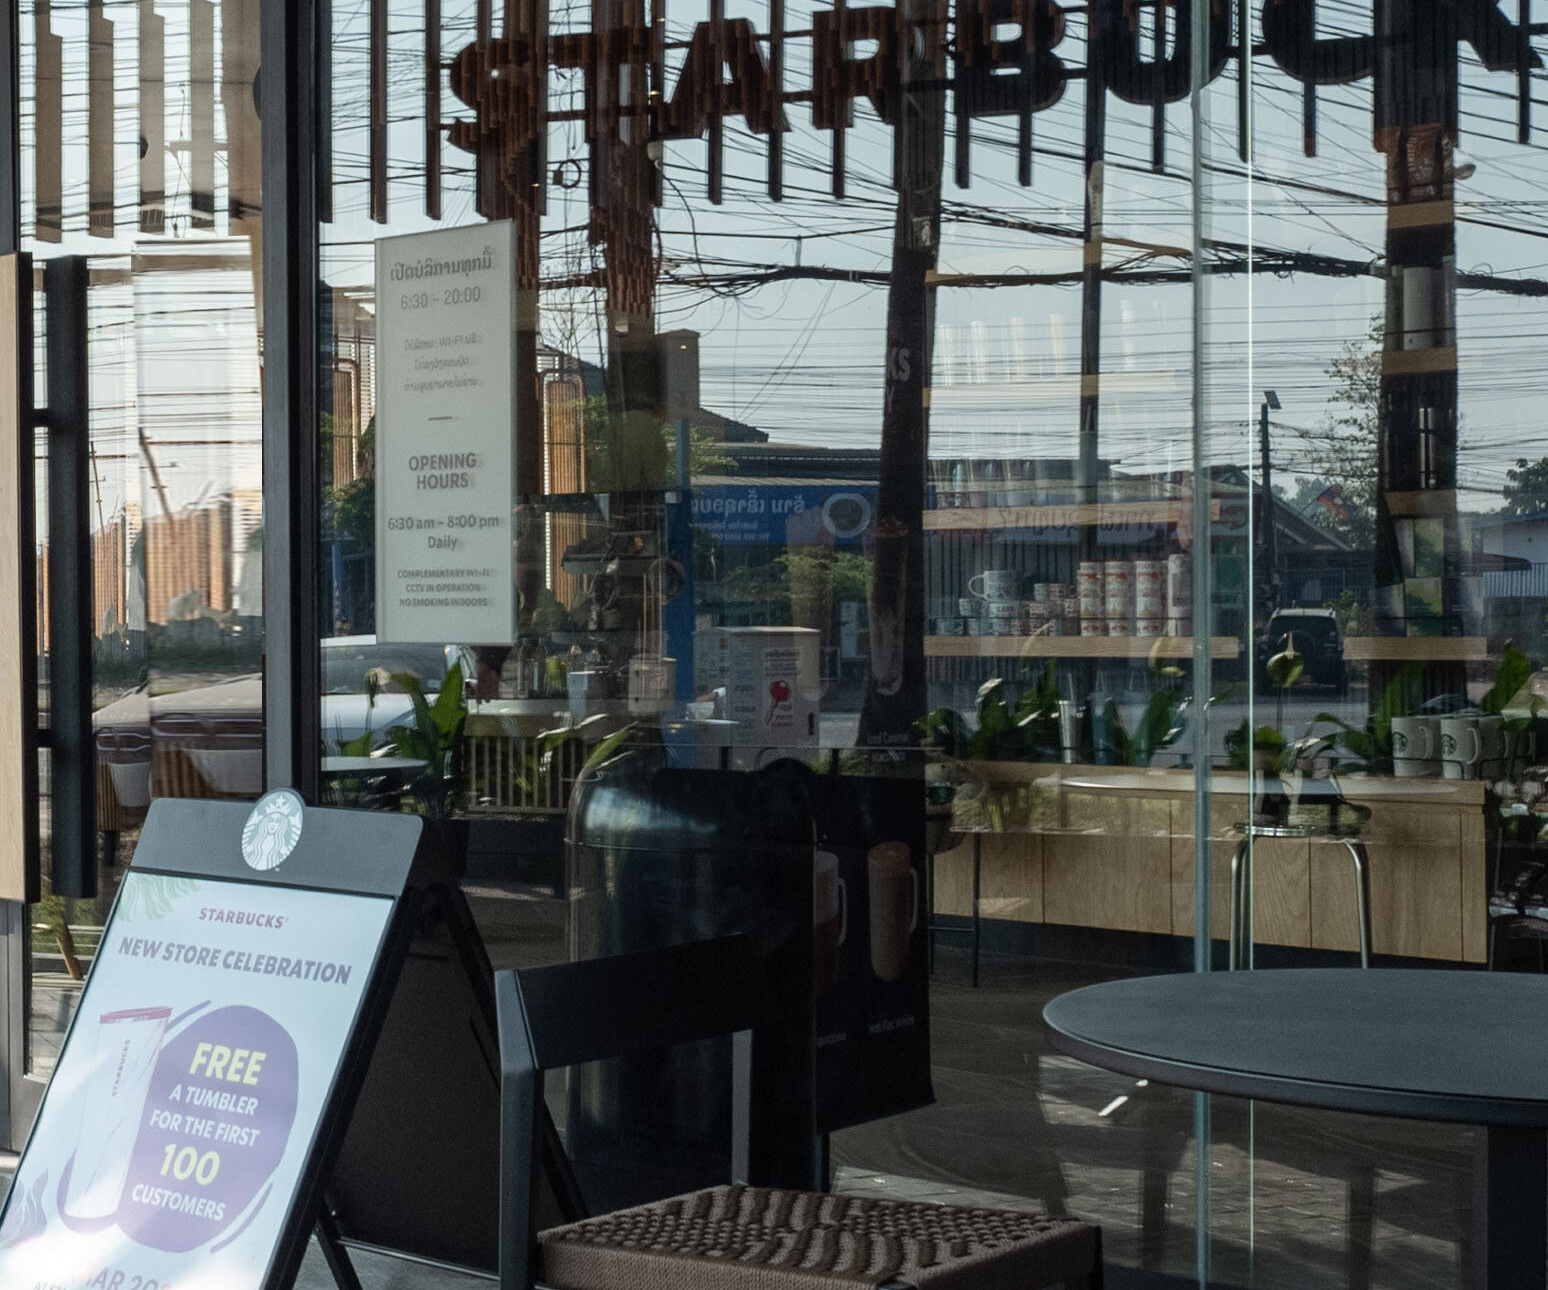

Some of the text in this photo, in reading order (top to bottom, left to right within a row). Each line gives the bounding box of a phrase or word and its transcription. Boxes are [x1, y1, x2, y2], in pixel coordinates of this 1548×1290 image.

[400, 292, 428, 311] 6:30
[444, 286, 481, 305] 20:00
[408, 452, 477, 471] OPENING
[417, 472, 469, 490] HOURS
[388, 517, 414, 530] 6:30
[416, 520, 434, 529] am
[447, 515, 476, 528] 8:00
[479, 516, 499, 529] pm
[428, 535, 457, 551] Daily
[397, 569, 465, 579] COMPLEMENTARY
[406, 583, 480, 592] CCTV IN OPERATION
[400, 598, 488, 607] NO SMOKING INDOORS
[120, 937, 352, 984] NEW STORE CELEBRATION
[189, 1042, 267, 1085] FREE
[169, 1084, 258, 1116] A TUMBLER
[150, 1109, 260, 1147] FOR THE FIRST
[160, 1143, 220, 1186] 100
[132, 1184, 227, 1220] CUSTOMERS
